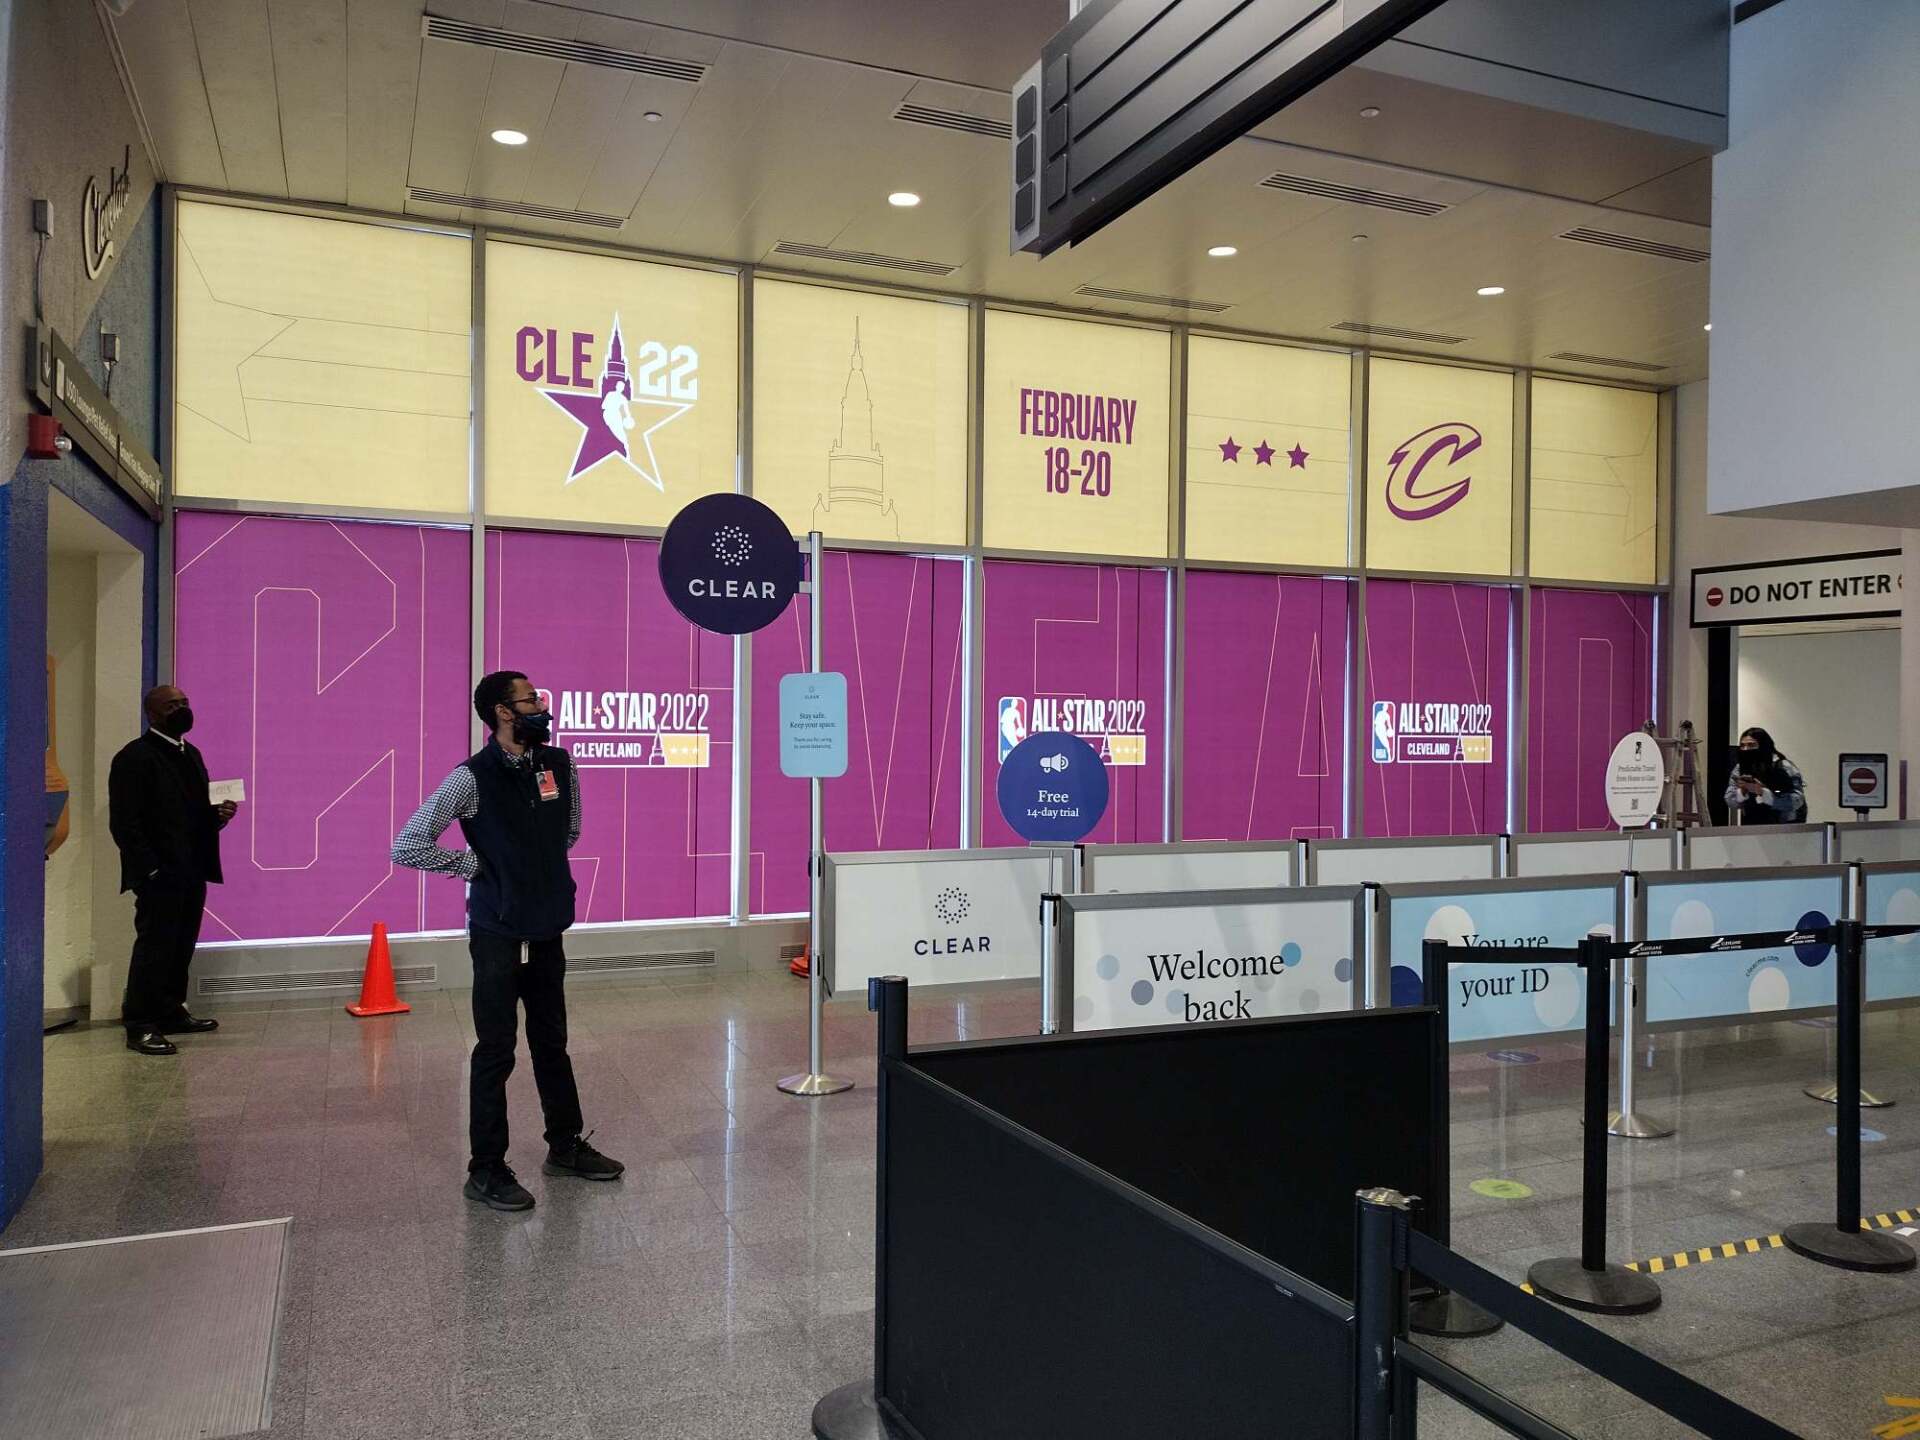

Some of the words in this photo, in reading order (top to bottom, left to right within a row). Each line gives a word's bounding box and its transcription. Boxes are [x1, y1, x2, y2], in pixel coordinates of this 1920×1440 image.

[516, 326, 594, 388] CLE
[639, 341, 699, 400] 22
[1020, 388, 1137, 445] FEBRUARY
[1044, 447, 1112, 497] 18-20
[688, 578, 776, 599] CLEAR
[1730, 585, 1760, 604] DO
[1767, 580, 1813, 602] NOT
[1820, 574, 1891, 598] ENTER
[660, 693, 709, 731] 2022
[1108, 700, 1146, 733] 2022
[1461, 704, 1492, 733] 2022
[573, 743, 641, 758] CLEVELAND
[1407, 743, 1450, 755] CLEVELAND
[1037, 790, 1069, 803] Free
[1027, 808, 1058, 819] 14-day
[1060, 808, 1080, 818] trial
[915, 936, 991, 956] CLEAR
[1147, 950, 1285, 982] Welcome
[1460, 975, 1515, 1007] your
[1520, 968, 1549, 993] ID
[1184, 990, 1252, 1022] back
